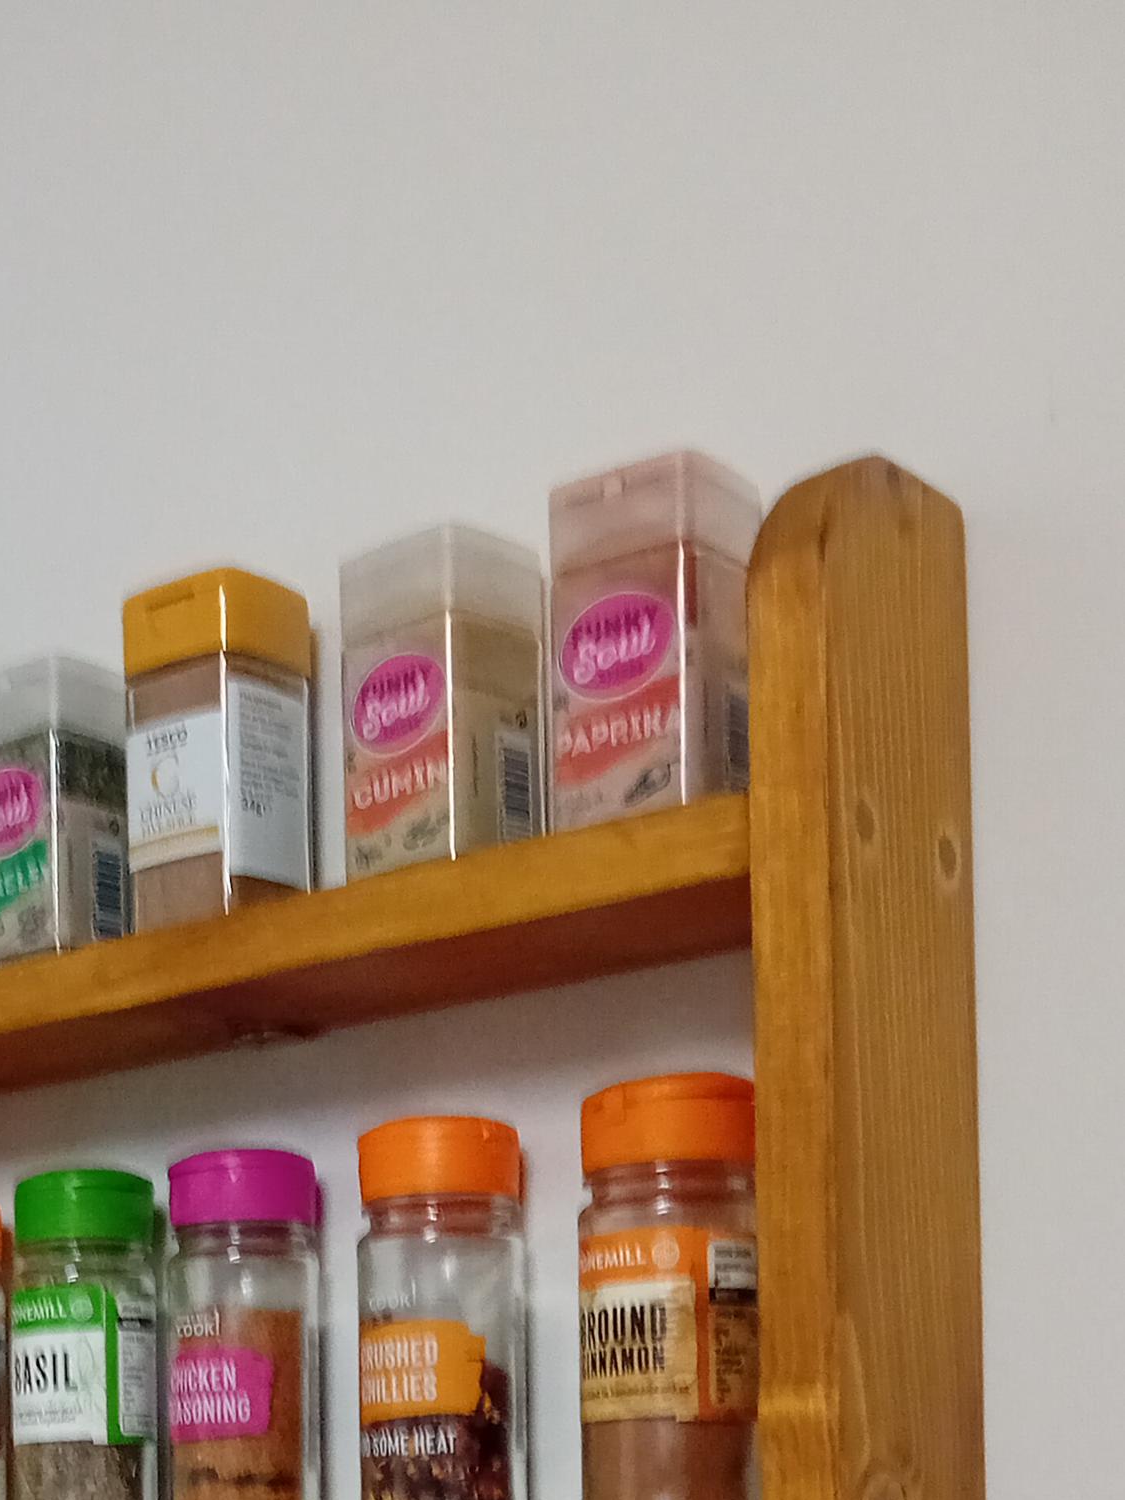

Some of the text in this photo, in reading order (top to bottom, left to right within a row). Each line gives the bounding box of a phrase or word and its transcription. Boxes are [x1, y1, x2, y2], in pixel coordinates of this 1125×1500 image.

[353, 757, 447, 810] CUMIN
[15, 1347, 78, 1396] BASIL
[372, 1427, 410, 1457] SOME
[413, 1421, 458, 1456] HEAT
